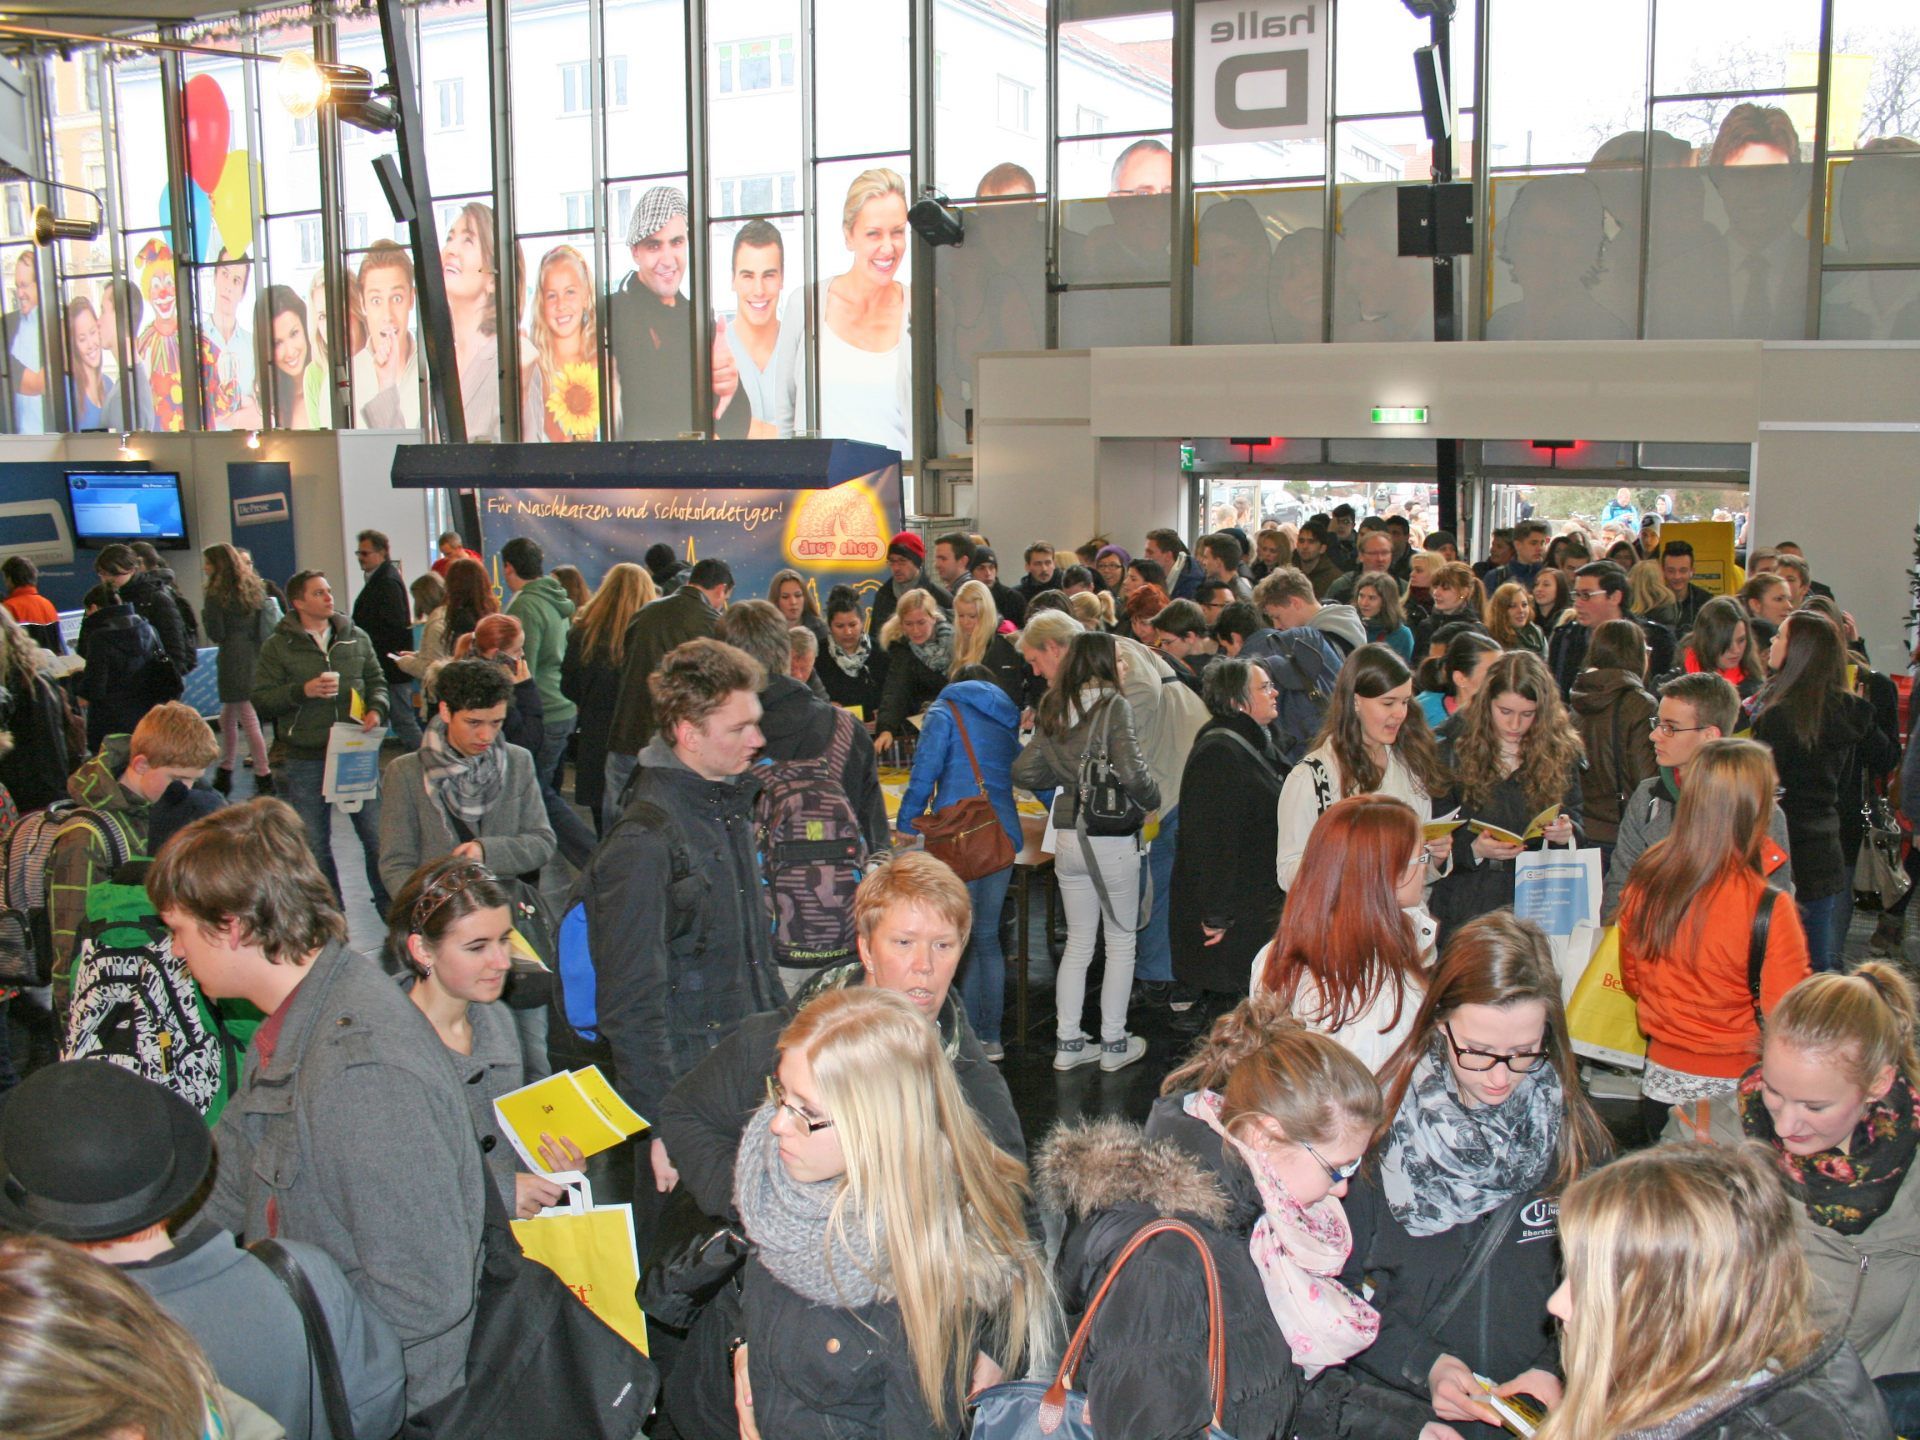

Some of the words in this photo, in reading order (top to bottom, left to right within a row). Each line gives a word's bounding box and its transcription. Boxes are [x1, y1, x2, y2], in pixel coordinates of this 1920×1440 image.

[488, 496, 512, 514] Für
[517, 495, 613, 521] Naschkatzen
[616, 500, 649, 519] und
[799, 540, 836, 557] drop
[840, 540, 878, 558] shop
